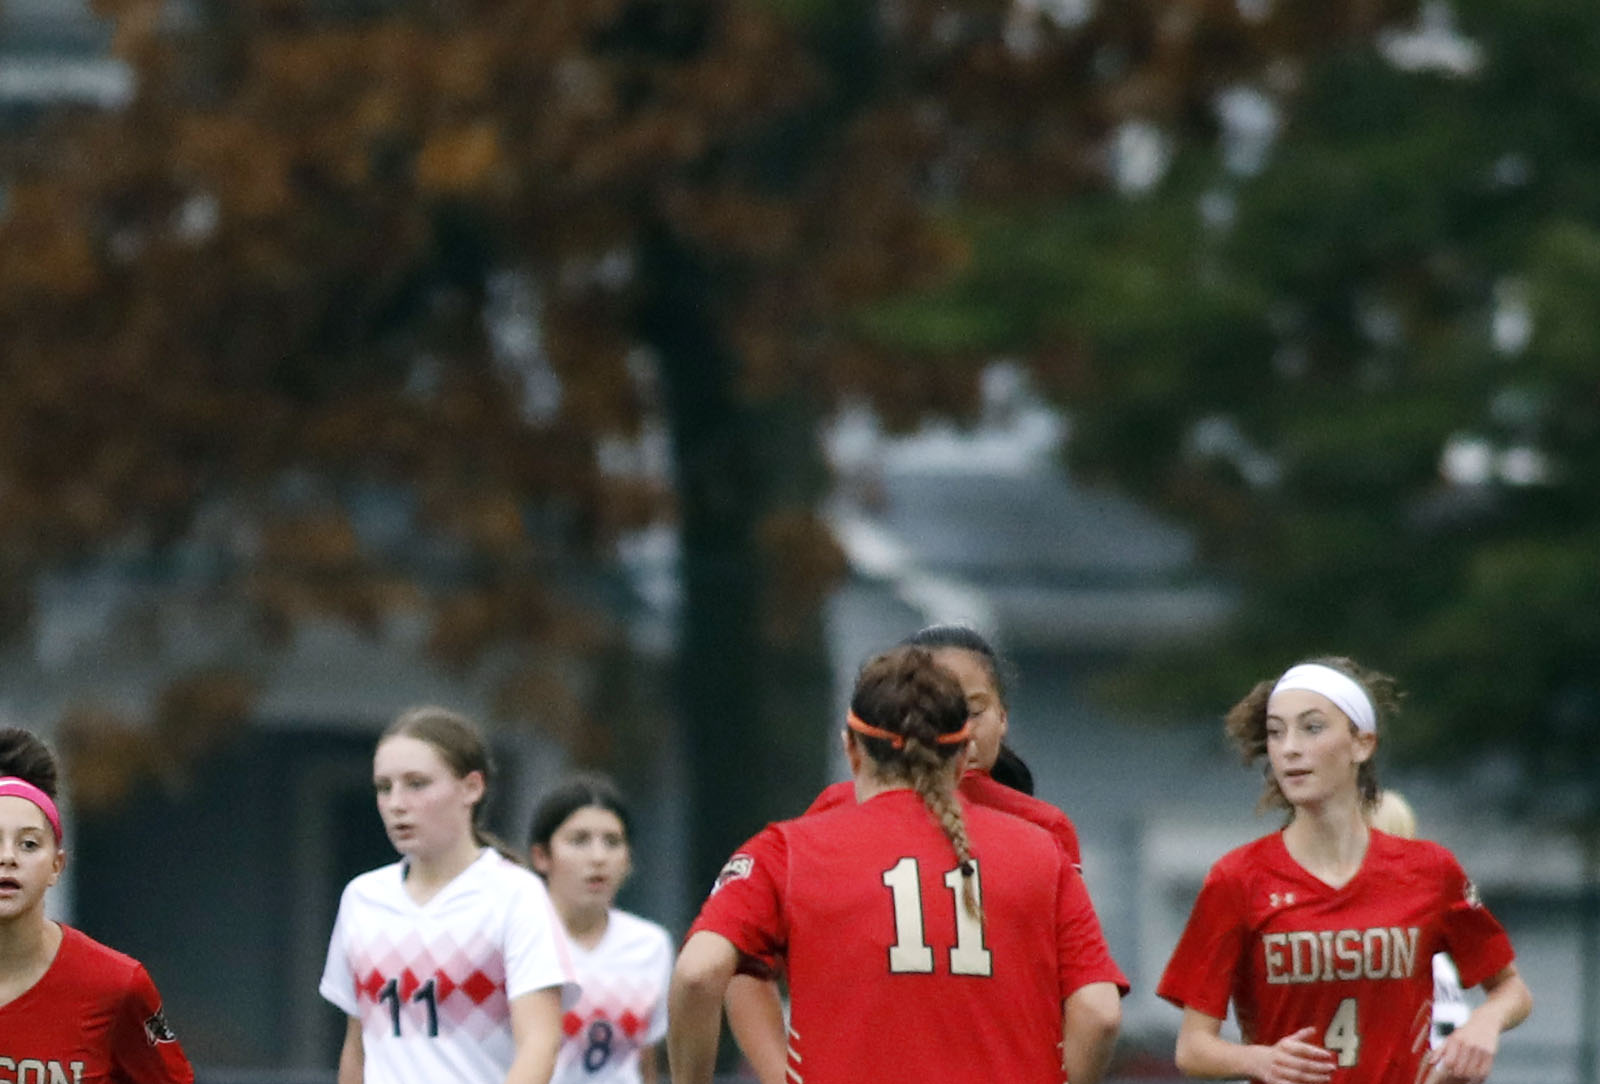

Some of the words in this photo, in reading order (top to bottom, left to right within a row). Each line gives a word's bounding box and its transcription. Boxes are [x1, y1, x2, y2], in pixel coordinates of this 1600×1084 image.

[882, 857, 993, 977] 11
[1262, 927, 1420, 985] EDISON
[379, 978, 439, 1038] 11
[1323, 997, 1361, 1067] 4
[583, 1020, 614, 1073] 8
